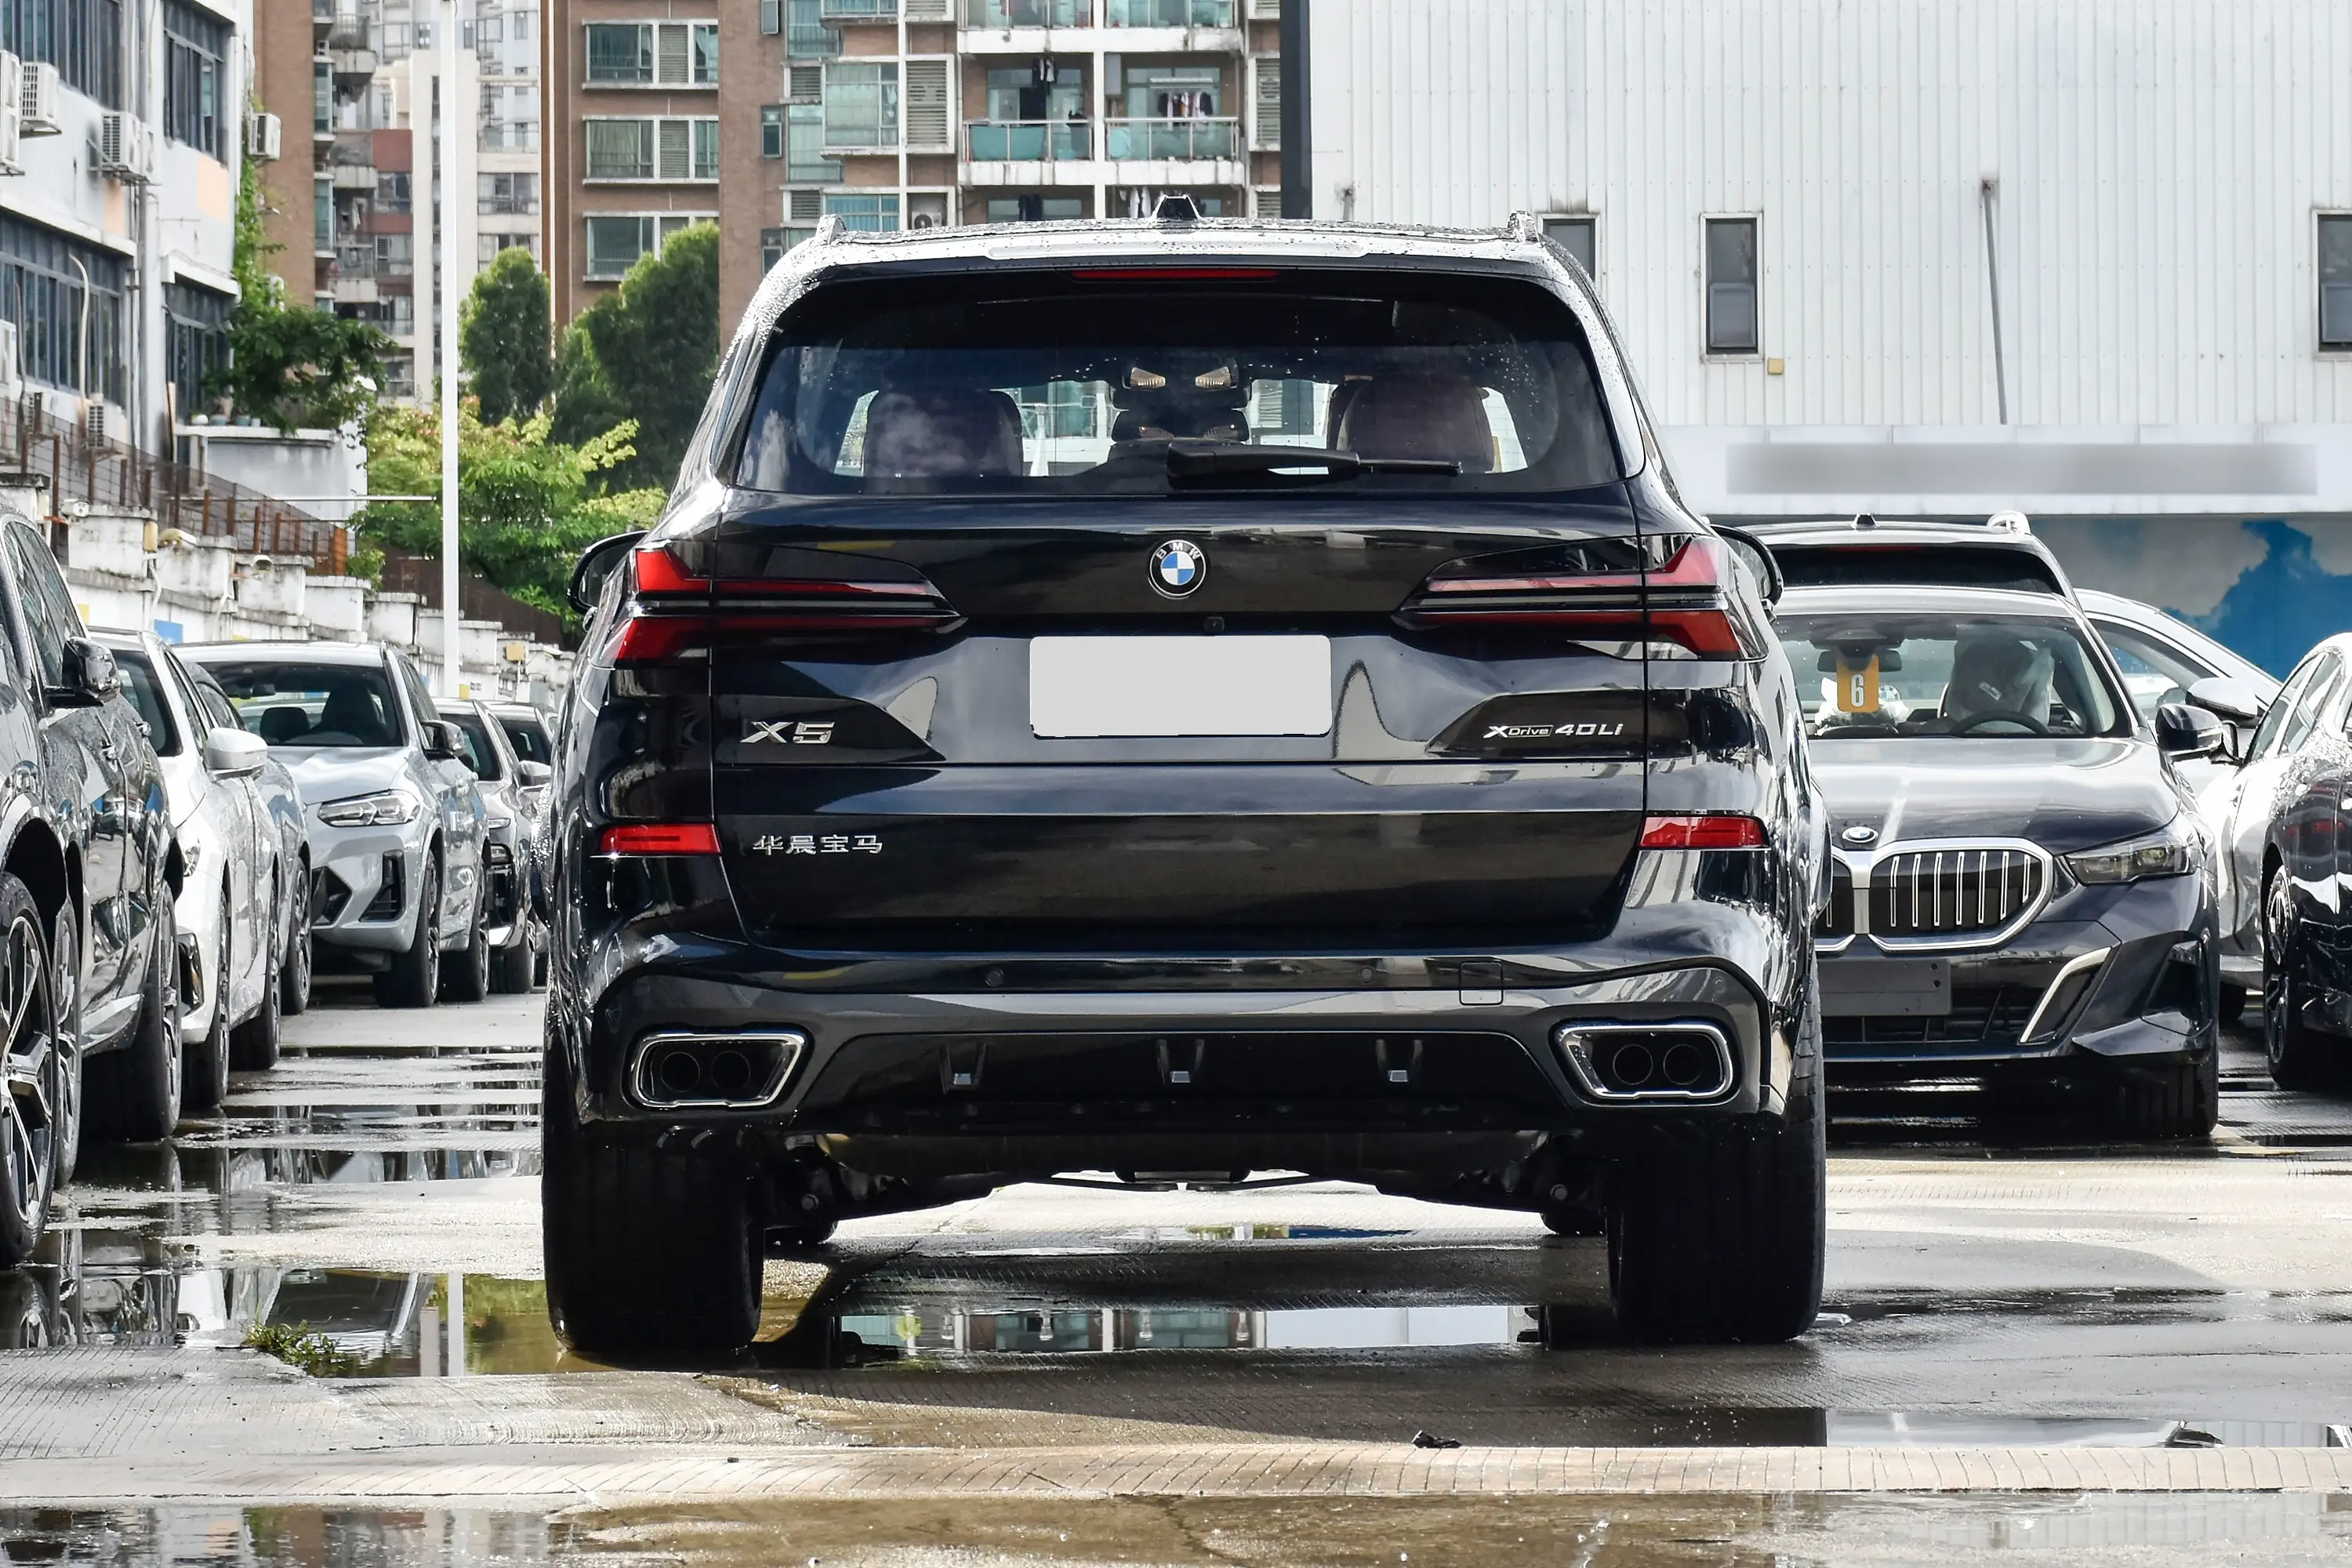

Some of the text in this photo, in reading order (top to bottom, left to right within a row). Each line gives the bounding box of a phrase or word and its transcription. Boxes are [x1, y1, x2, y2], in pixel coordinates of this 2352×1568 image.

[1156, 541, 1201, 560] BMW
[1851, 674, 1864, 707] 6
[740, 721, 835, 743] X5
[753, 834, 883, 855] 华晨宝马
